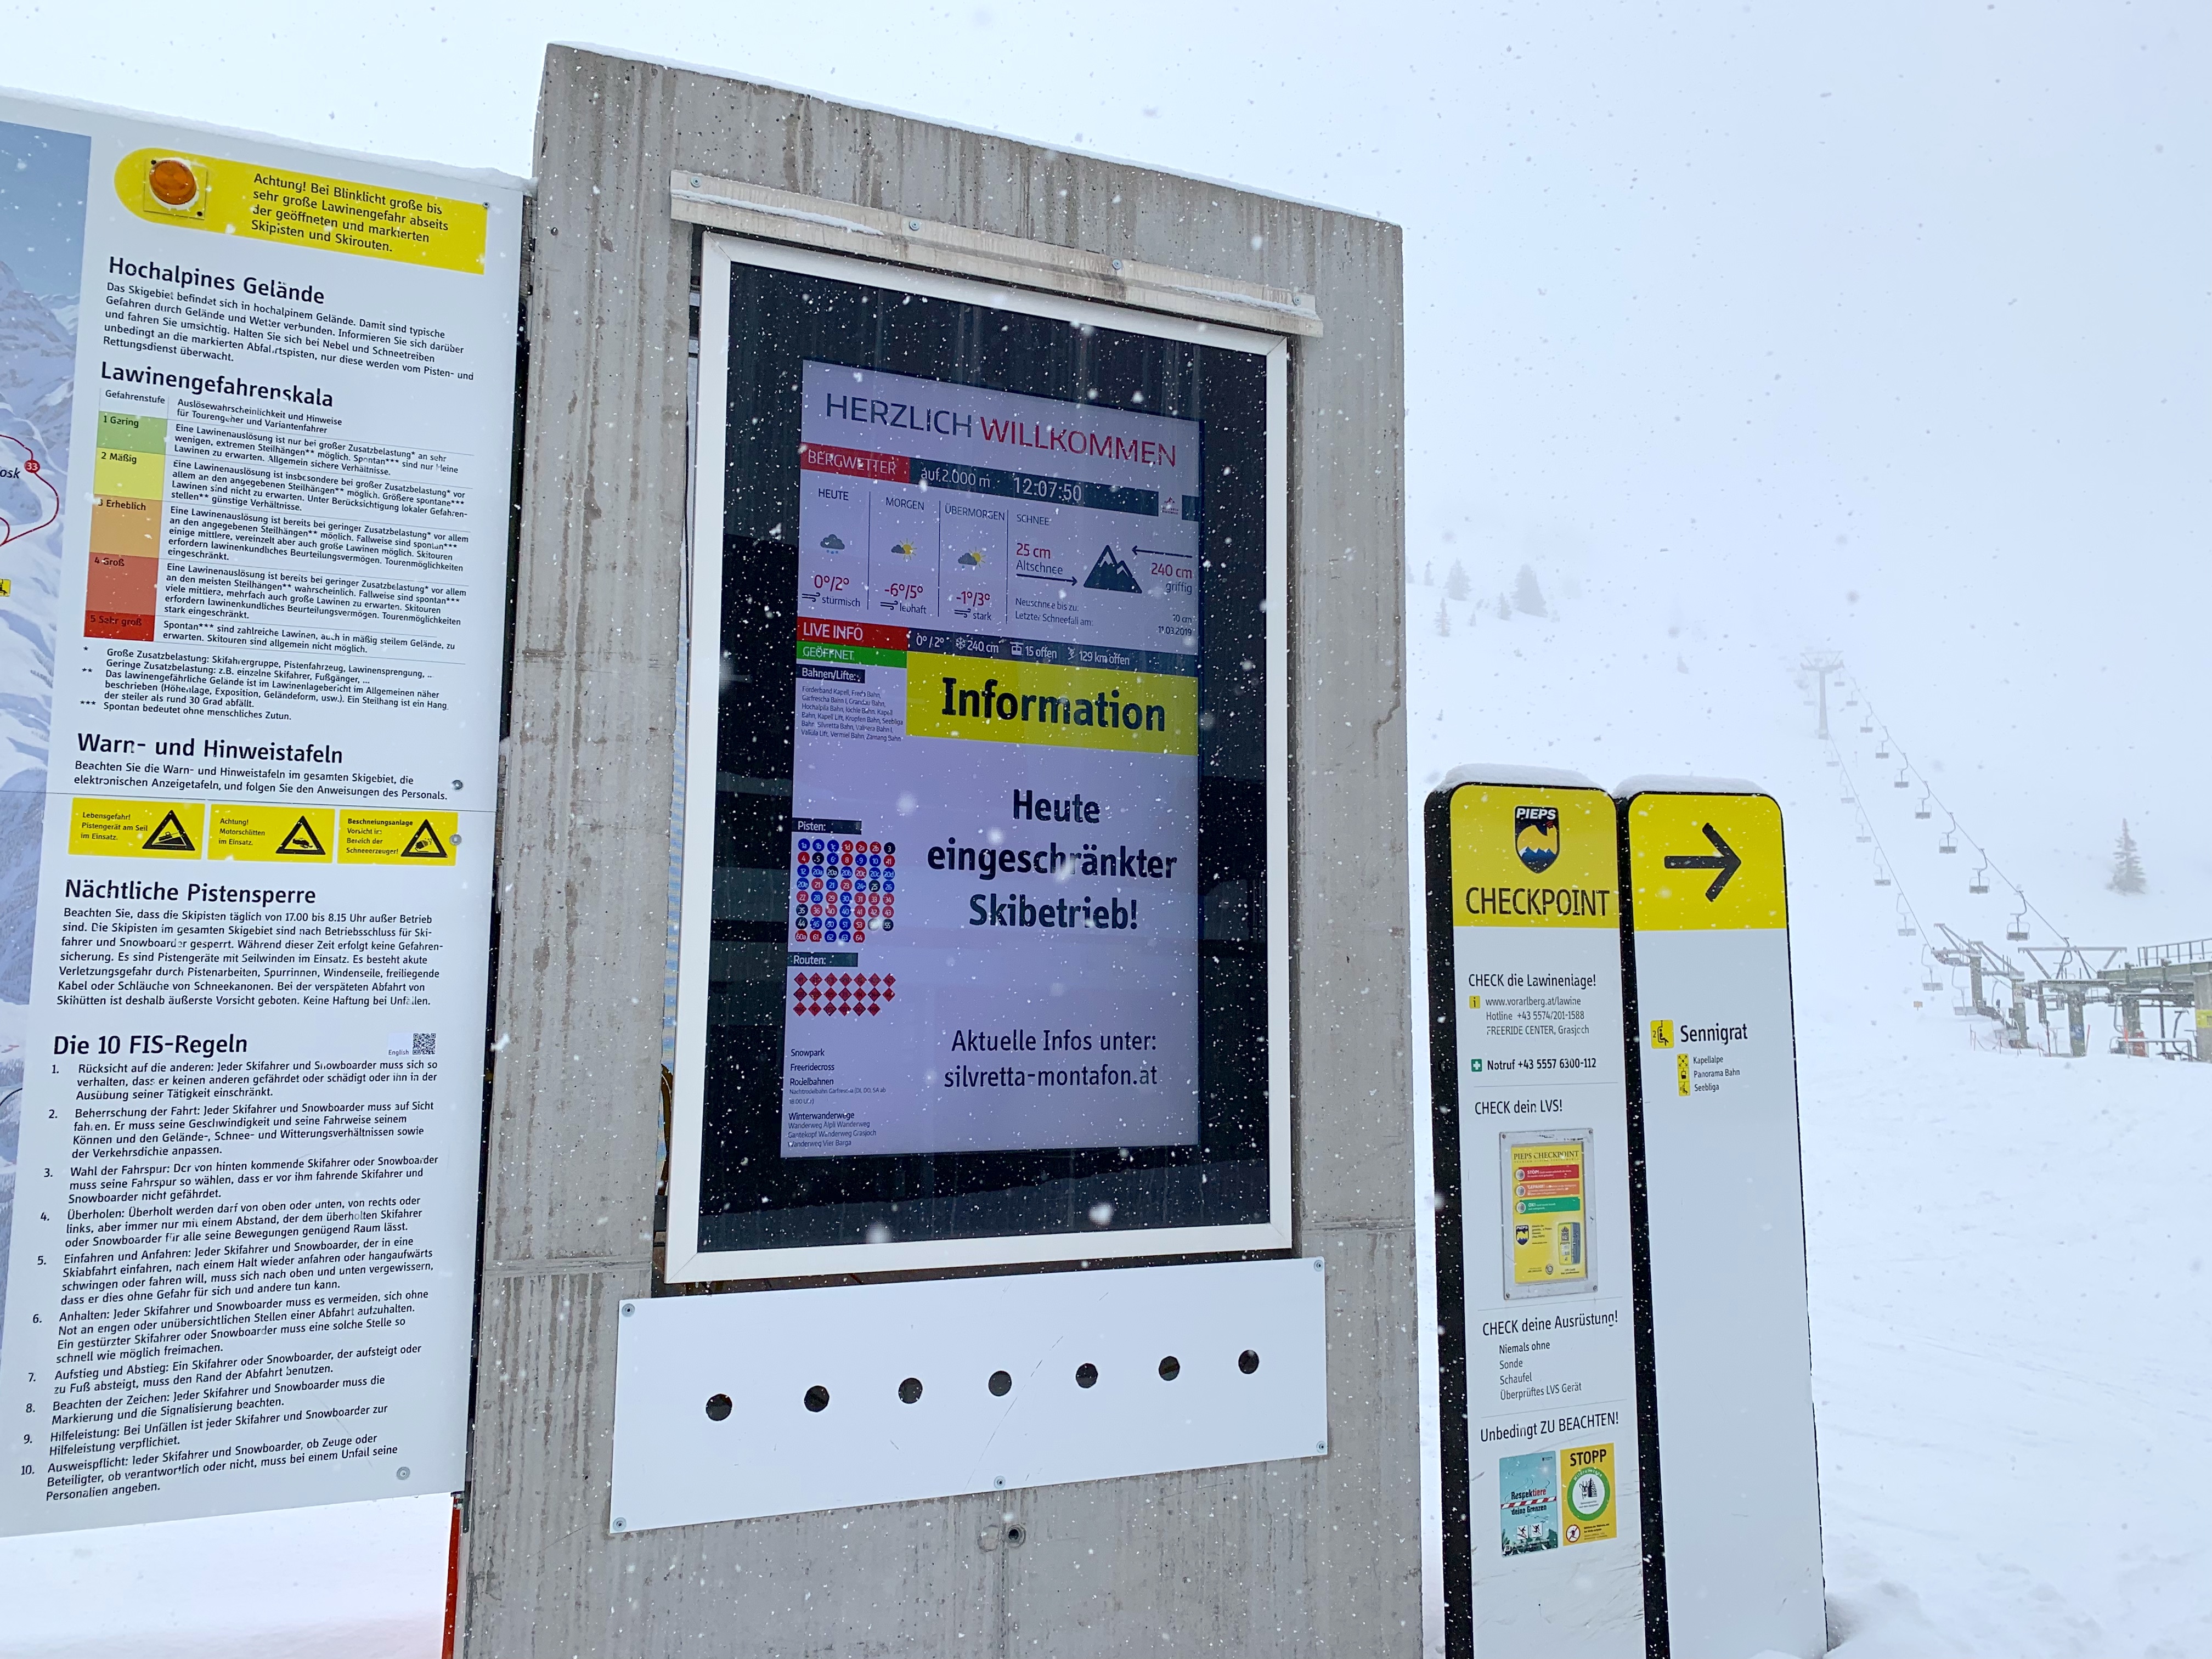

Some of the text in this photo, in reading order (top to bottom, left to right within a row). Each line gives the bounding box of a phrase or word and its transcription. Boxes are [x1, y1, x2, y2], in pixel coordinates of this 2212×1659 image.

[254, 173, 442, 215] Achtung! Bei Blinklicht große bis
[253, 190, 448, 230] sehr große Lawinengefahr abseits
[253, 205, 428, 242] der geöffneten und markierten
[251, 219, 392, 252] Skipisten und Skirouten.
[109, 256, 325, 304] Hochalpines Gelände
[103, 336, 234, 361] Rettungsdienst überwacht.
[101, 362, 333, 407] Lawinengefahrenskala
[105, 390, 165, 404] Gefahrenstufe
[110, 416, 139, 428] Gering
[826, 393, 1176, 467] HERZLICH WILLKOMMEN
[110, 453, 137, 465] Mäßig
[27, 462, 37, 471] 33
[808, 450, 896, 475] BERGWETTER
[979, 475, 990, 488] m
[1014, 477, 1082, 501] 12:07:50
[106, 500, 146, 510] Erheblich
[819, 488, 1005, 521] HEUTE MORGEN ÜBERMORGEN
[1017, 514, 1050, 525] SCHNEE
[1017, 543, 1051, 559] 25 cm
[103, 558, 125, 567] Groß
[1017, 560, 1063, 575] Altschnee
[1151, 563, 1192, 579] 240 cm
[1166, 582, 1192, 595] griffig
[822, 595, 860, 607] stürmisch
[973, 611, 991, 620] stark
[99, 616, 118, 624] Sehr
[122, 618, 142, 627] groß
[803, 622, 863, 640] LIVE INFO
[1158, 626, 1192, 636] 11.03.2019
[803, 646, 854, 660] GEÖFFNET
[1079, 651, 1130, 665] 129 km offen
[941, 676, 1165, 732] Information
[78, 733, 342, 763] Warn- und Hinweistafeln
[1013, 789, 1101, 824] Heute
[83, 812, 131, 821] Lebensgefahr!
[1516, 808, 1556, 820] PIEPS
[82, 822, 121, 831] Pistengerät
[219, 818, 249, 826] Achtung!
[348, 819, 413, 827] Beschneiungsanlage
[798, 820, 826, 831] Pisten:
[927, 837, 1177, 881] eingeschränkter
[65, 879, 315, 907] Nächtliche Pistensperre
[1466, 887, 1610, 917] CHECKPOINT
[969, 894, 1138, 929] Skibetrieb!
[60, 951, 427, 964] sicherung. Es sind Pistengeräte mit Seilwinden im Einsatz. Es besteht akute
[793, 954, 826, 966] Routen:
[1469, 973, 1596, 988] CHECK die Lawinenlage!
[1486, 996, 1581, 1008] www.vorarlberg.at/lawine
[1486, 1011, 1584, 1020] Hotline +43 5574/201-1588
[1487, 1025, 1589, 1036] FREERIDE CENTER, Grasjoch
[1680, 1023, 1748, 1045] Sennigrat
[54, 1034, 247, 1058] Die 10 FIS-Regeln
[951, 1029, 1156, 1052] Aktuelle Infos unter:
[791, 1049, 825, 1058] Snowpark
[1694, 1055, 1723, 1065] Kapellalpe
[790, 1063, 834, 1071] Freeridecross
[1487, 1058, 1596, 1070] Notruf +43 5557 6300-112
[944, 1065, 1158, 1088] silvretta-montafon.at
[1695, 1083, 1719, 1092] Seebliga
[1475, 1099, 1562, 1115] CHECK dein LVS!
[788, 1112, 854, 1120] Winterwanderwege
[1534, 1150, 1579, 1159] CHECKPOINT
[1483, 1310, 1617, 1336] CHECK deine Ausrüstung!
[1499, 1341, 1550, 1354] Niemals ohne
[1500, 1358, 1522, 1369] Sonde
[1500, 1372, 1532, 1385] Schaufel
[1500, 1382, 1582, 1400] Überprüftes LVS Gerät
[1481, 1412, 1618, 1442] Unbedingt ZU BEACHTEN!
[1570, 1449, 1607, 1466] STOPP
[46, 1482, 160, 1501] Personalien angeben.
[1511, 1488, 1547, 1500] Respektiere
[1527, 1505, 1547, 1514] Grenzen
